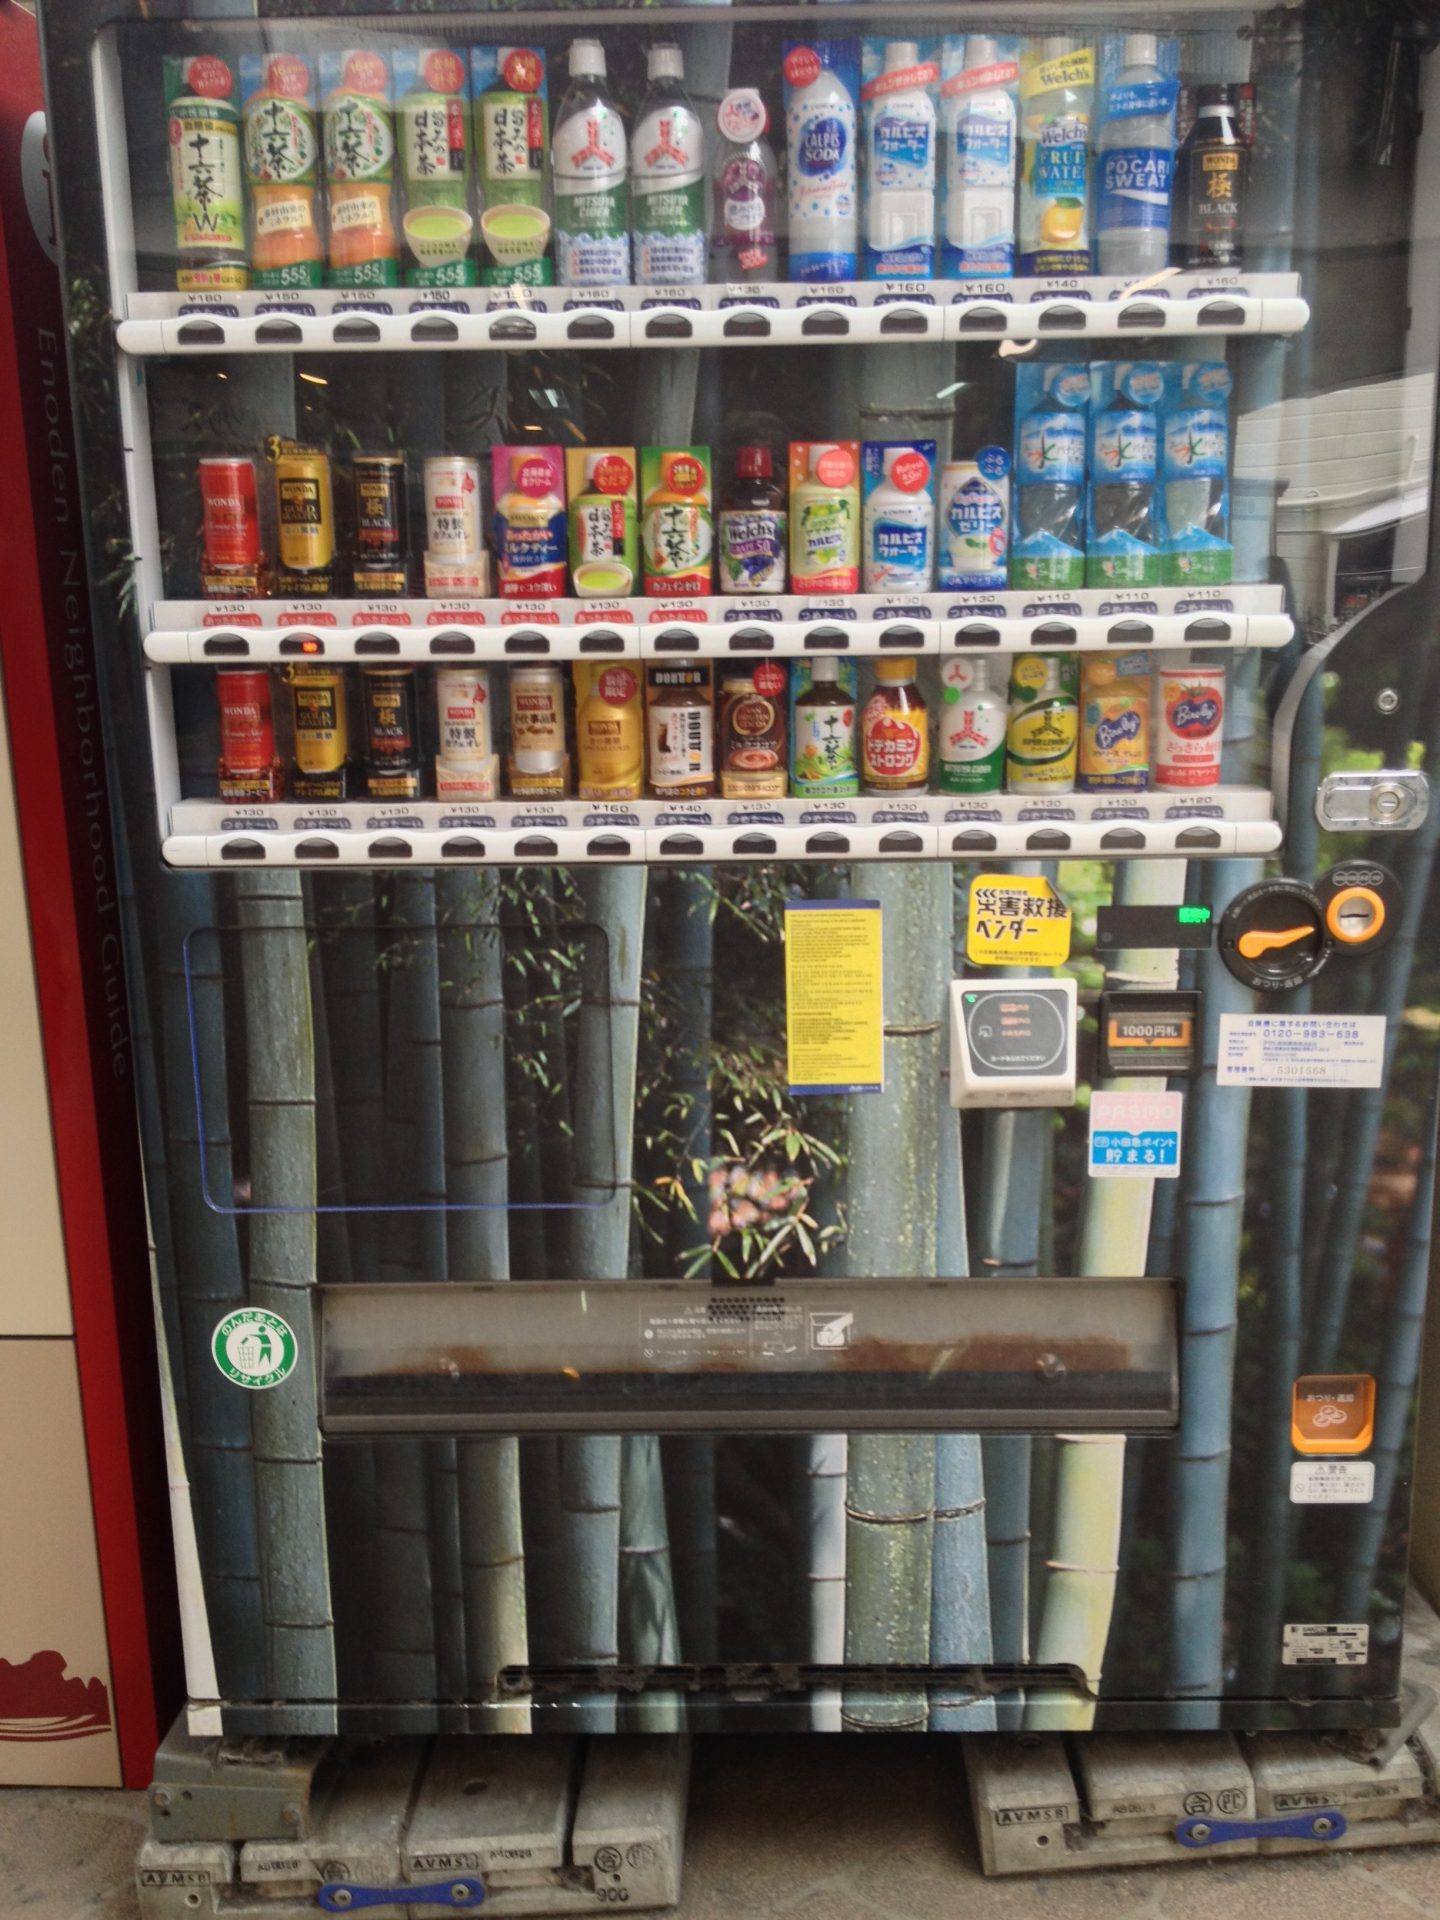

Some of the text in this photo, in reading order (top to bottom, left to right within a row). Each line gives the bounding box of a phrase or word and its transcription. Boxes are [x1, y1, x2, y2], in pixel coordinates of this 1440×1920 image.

[803, 132, 841, 147] CALPIS
[879, 126, 927, 139] カルピス
[804, 148, 840, 162] SODA
[1105, 158, 1169, 175] POCARI
[1104, 172, 1167, 190] SWEAT
[1199, 201, 1238, 214] BLACK
[951, 503, 1003, 520] カルピス
[728, 522, 775, 540] Welch's
[959, 520, 996, 533] ゼリー
[661, 506, 693, 568] 十六茶
[878, 532, 923, 545] カルピス
[655, 672, 702, 684] DOUTOR
[37, 327, 129, 1080] Enoden Neighborhood Guide
[821, 714, 846, 771] 十六茶
[975, 888, 1068, 918] 災害救援
[975, 919, 1038, 940] ベンダー
[1122, 1025, 1178, 1037] 1000円札
